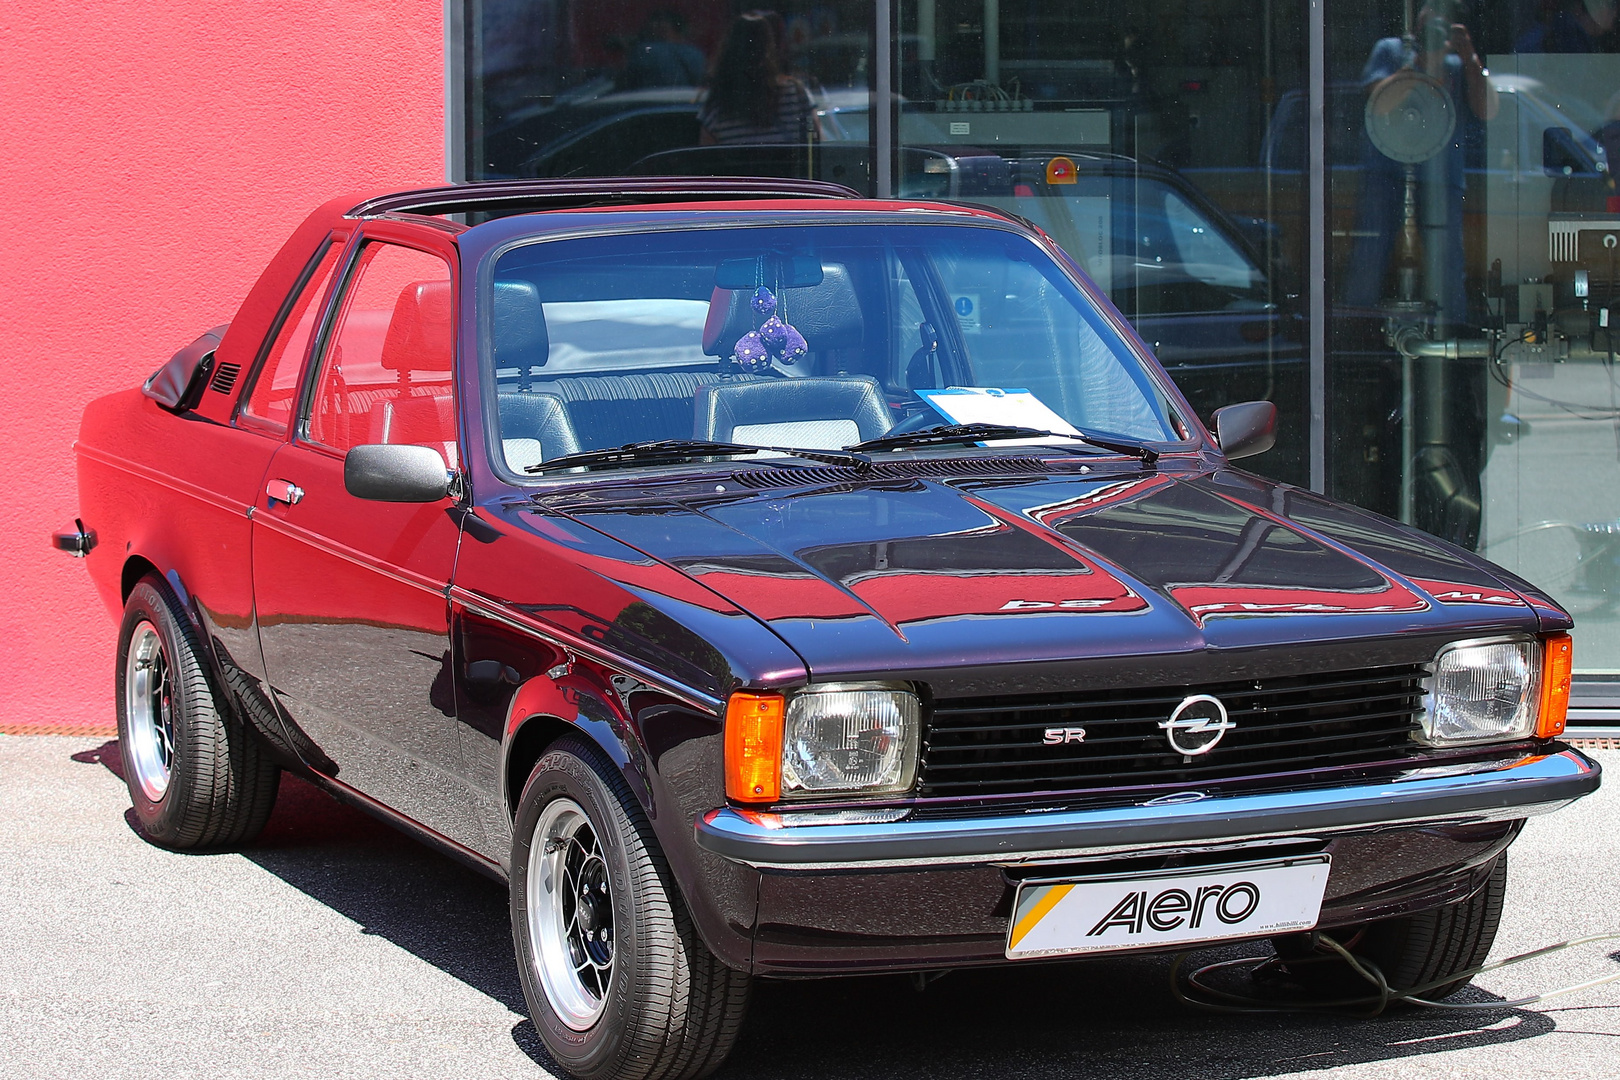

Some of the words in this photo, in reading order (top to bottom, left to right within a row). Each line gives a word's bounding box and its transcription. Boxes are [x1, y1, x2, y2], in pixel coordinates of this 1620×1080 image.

[1043, 727, 1086, 745] SR
[1085, 881, 1261, 937] Aero
[614, 870, 631, 1016] DUNLOP
